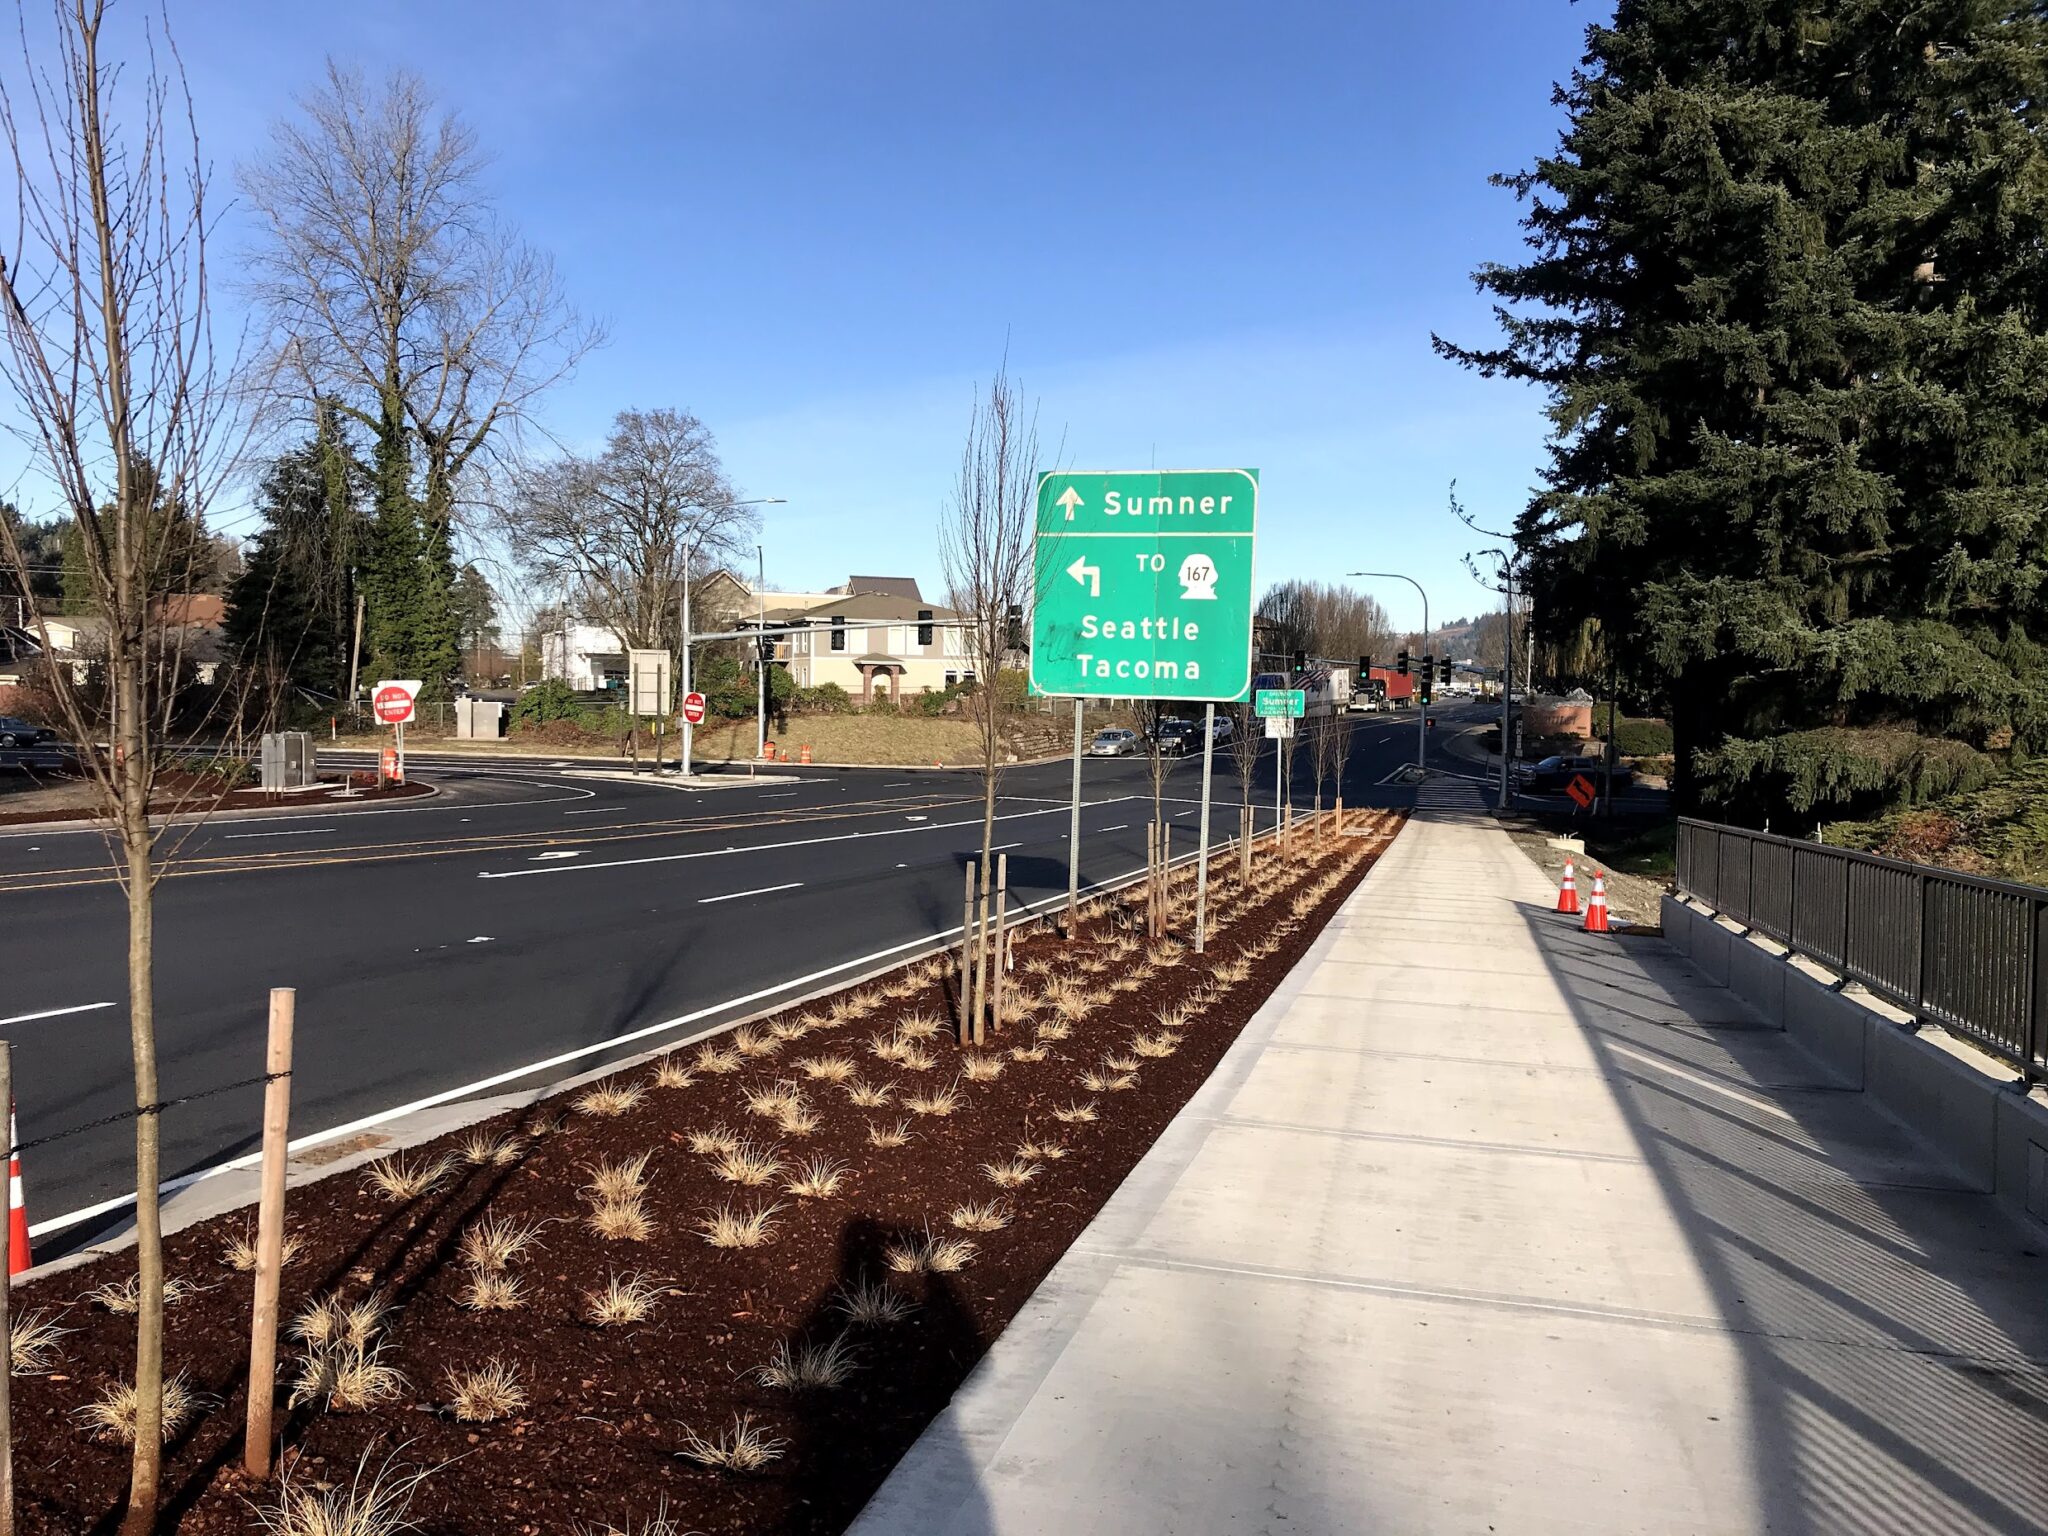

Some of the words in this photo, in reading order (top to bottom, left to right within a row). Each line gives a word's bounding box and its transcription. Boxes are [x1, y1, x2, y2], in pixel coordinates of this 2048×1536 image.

[1103, 491, 1233, 516] Sumner
[1135, 553, 1166, 572] TO
[1186, 566, 1210, 581] 167
[1081, 614, 1200, 641] Seattle
[1076, 653, 1200, 680] Tacoma
[384, 708, 405, 716] ENTER
